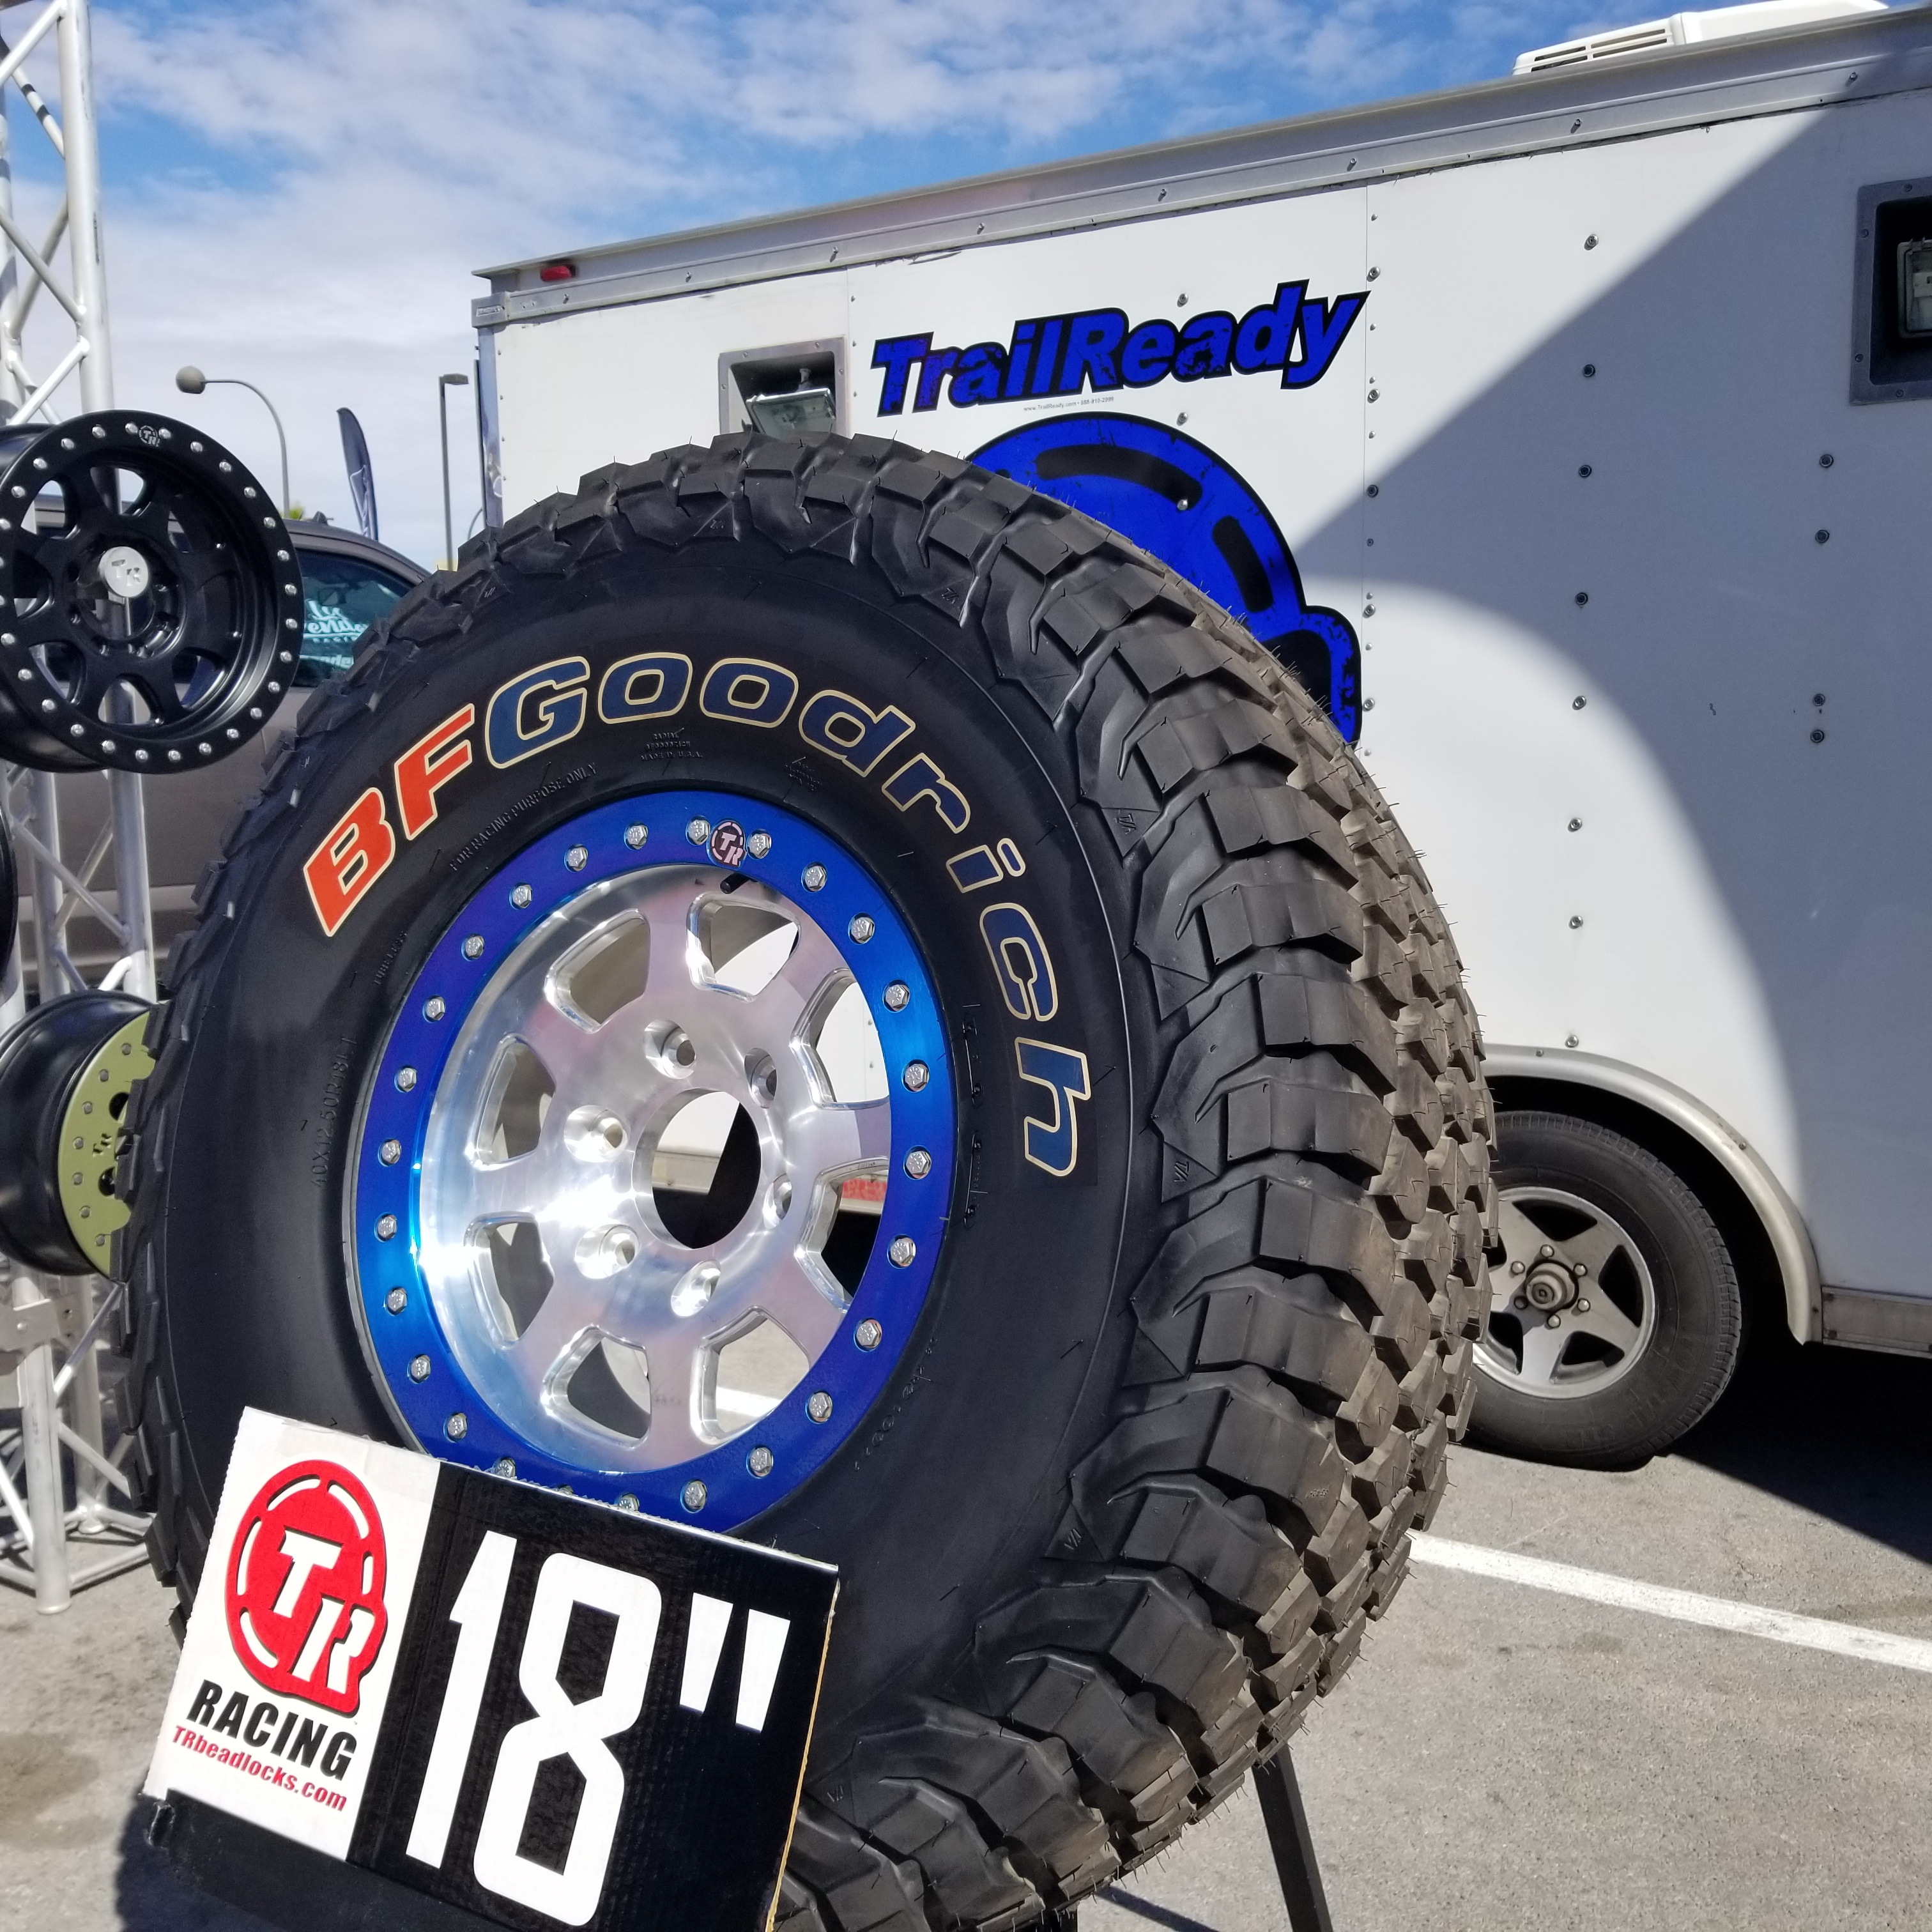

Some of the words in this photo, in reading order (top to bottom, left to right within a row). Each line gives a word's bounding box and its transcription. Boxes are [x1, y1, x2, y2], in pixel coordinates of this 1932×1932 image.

[870, 279, 1370, 417] TrailReady
[111, 559, 141, 586] TR
[449, 846, 473, 871] FOR
[471, 812, 511, 850] RACING
[510, 777, 565, 817] PURPOSE
[566, 763, 597, 785] ONLY
[719, 832, 744, 866] TR
[303, 652, 1092, 1177] BFGoodrich
[272, 1529, 376, 1695] TR
[172, 1726, 348, 1813] TRbeadlocks.com
[186, 1678, 358, 1781] RACING
[405, 1530, 791, 1926] 18"
